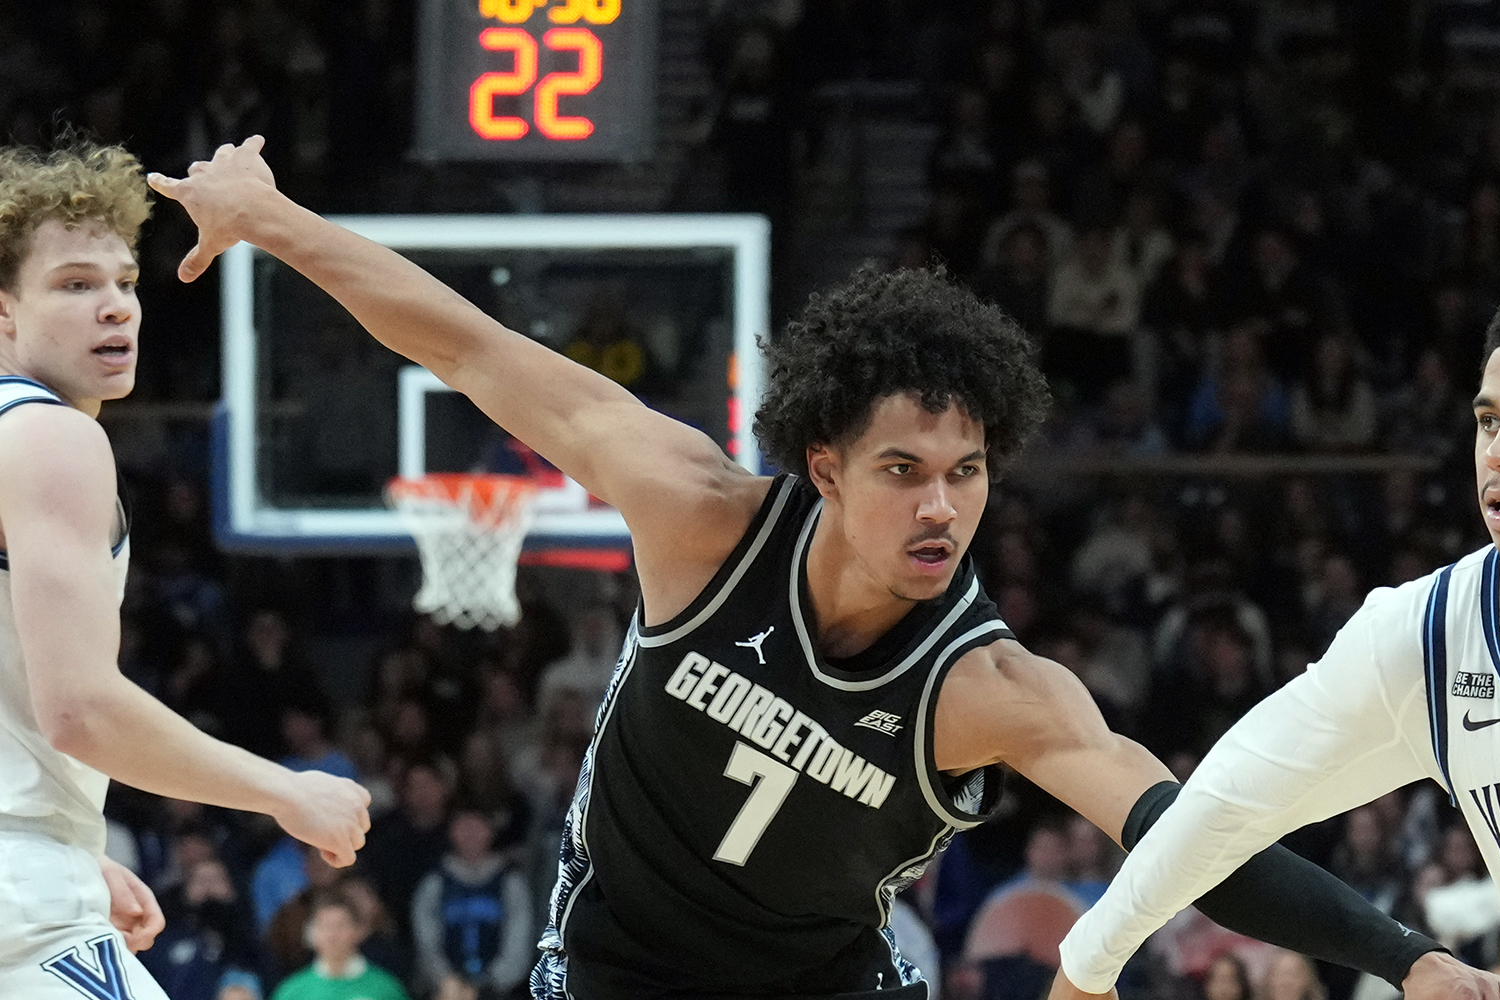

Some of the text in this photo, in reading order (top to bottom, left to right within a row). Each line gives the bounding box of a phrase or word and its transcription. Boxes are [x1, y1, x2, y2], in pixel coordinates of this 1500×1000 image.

[469, 27, 603, 140] 22
[1455, 672, 1493, 687] BE THE
[1452, 683, 1494, 698] CHANGE
[859, 716, 904, 733] EAST
[868, 709, 902, 723] BIG
[664, 650, 897, 810] GEORGETOWN
[712, 740, 800, 867] 7
